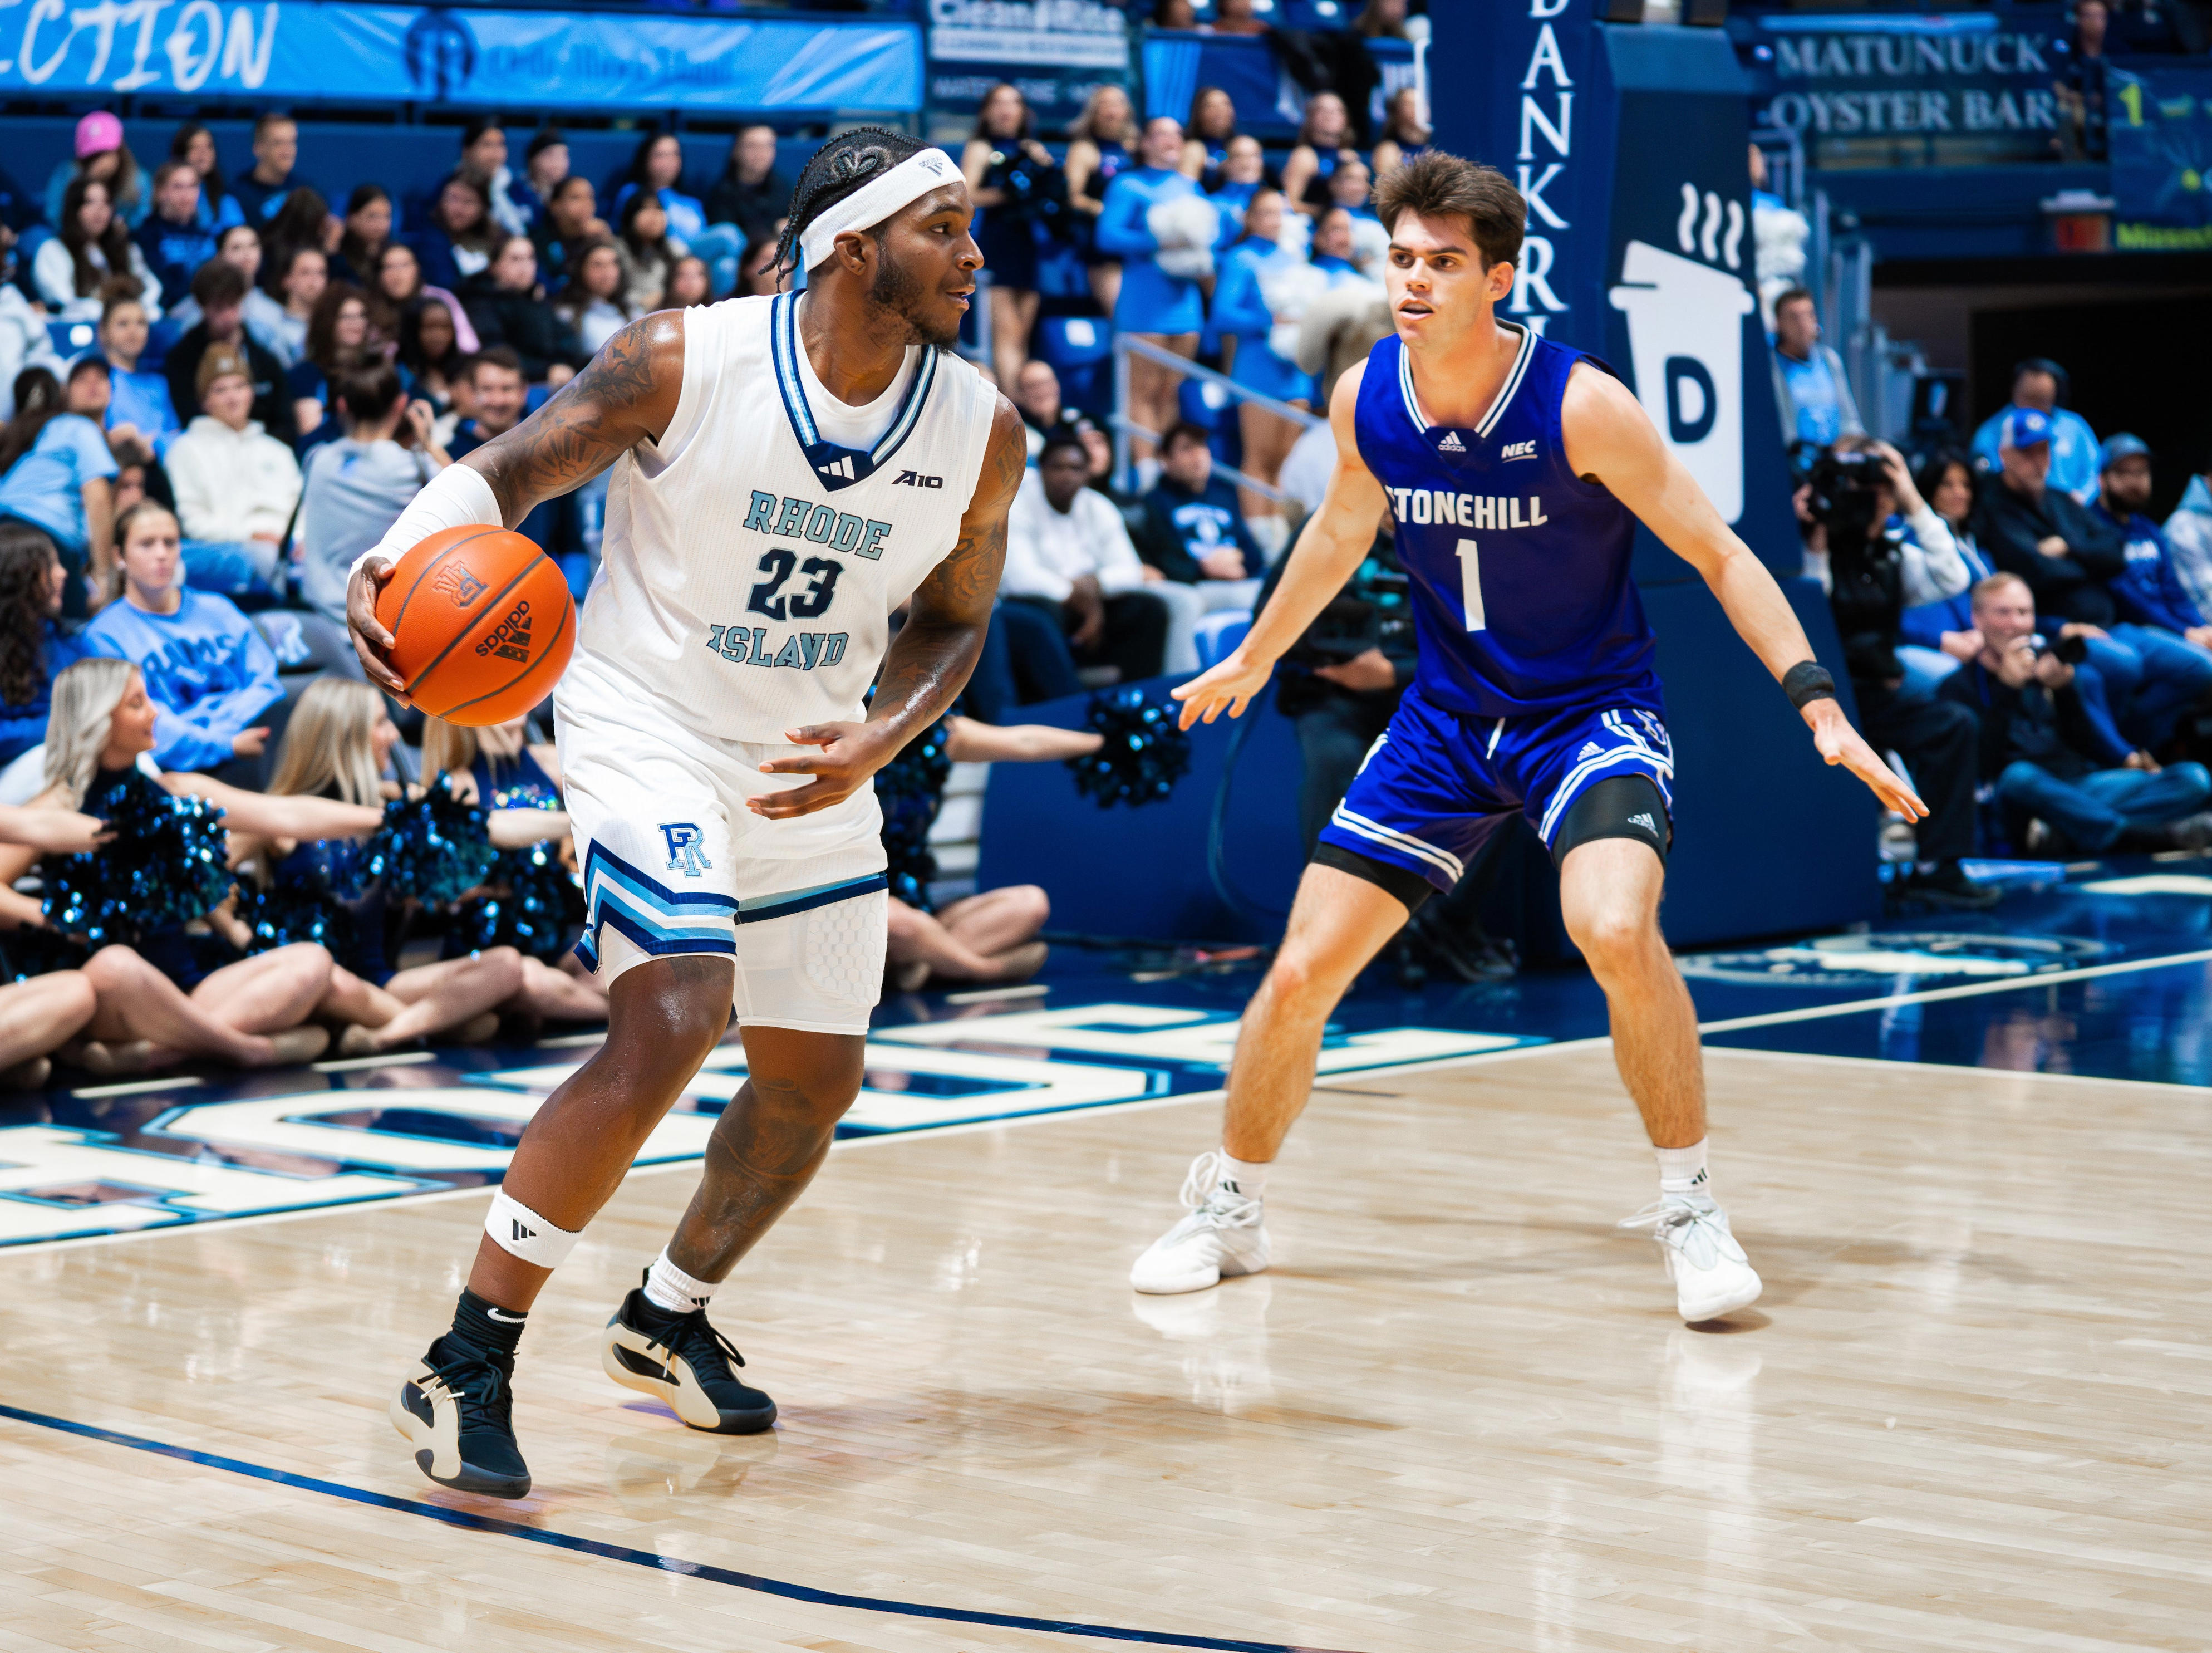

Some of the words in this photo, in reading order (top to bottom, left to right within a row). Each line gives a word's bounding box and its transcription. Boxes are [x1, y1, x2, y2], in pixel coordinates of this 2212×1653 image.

[0, 0, 279, 92] CTION
[1776, 34, 2049, 76] MATUNUCK
[1770, 90, 1952, 132] OYSTER
[1962, 88, 2058, 130] BAR
[1665, 355, 1717, 444] D
[1438, 444, 1467, 452] adidas
[1501, 440, 1536, 459] NEC
[891, 469, 943, 489] A10
[743, 489, 892, 561] RHODE
[745, 546, 846, 622] 23
[1456, 539, 1486, 632] 1
[475, 600, 530, 657] adidas
[706, 624, 849, 671] ISLAND
